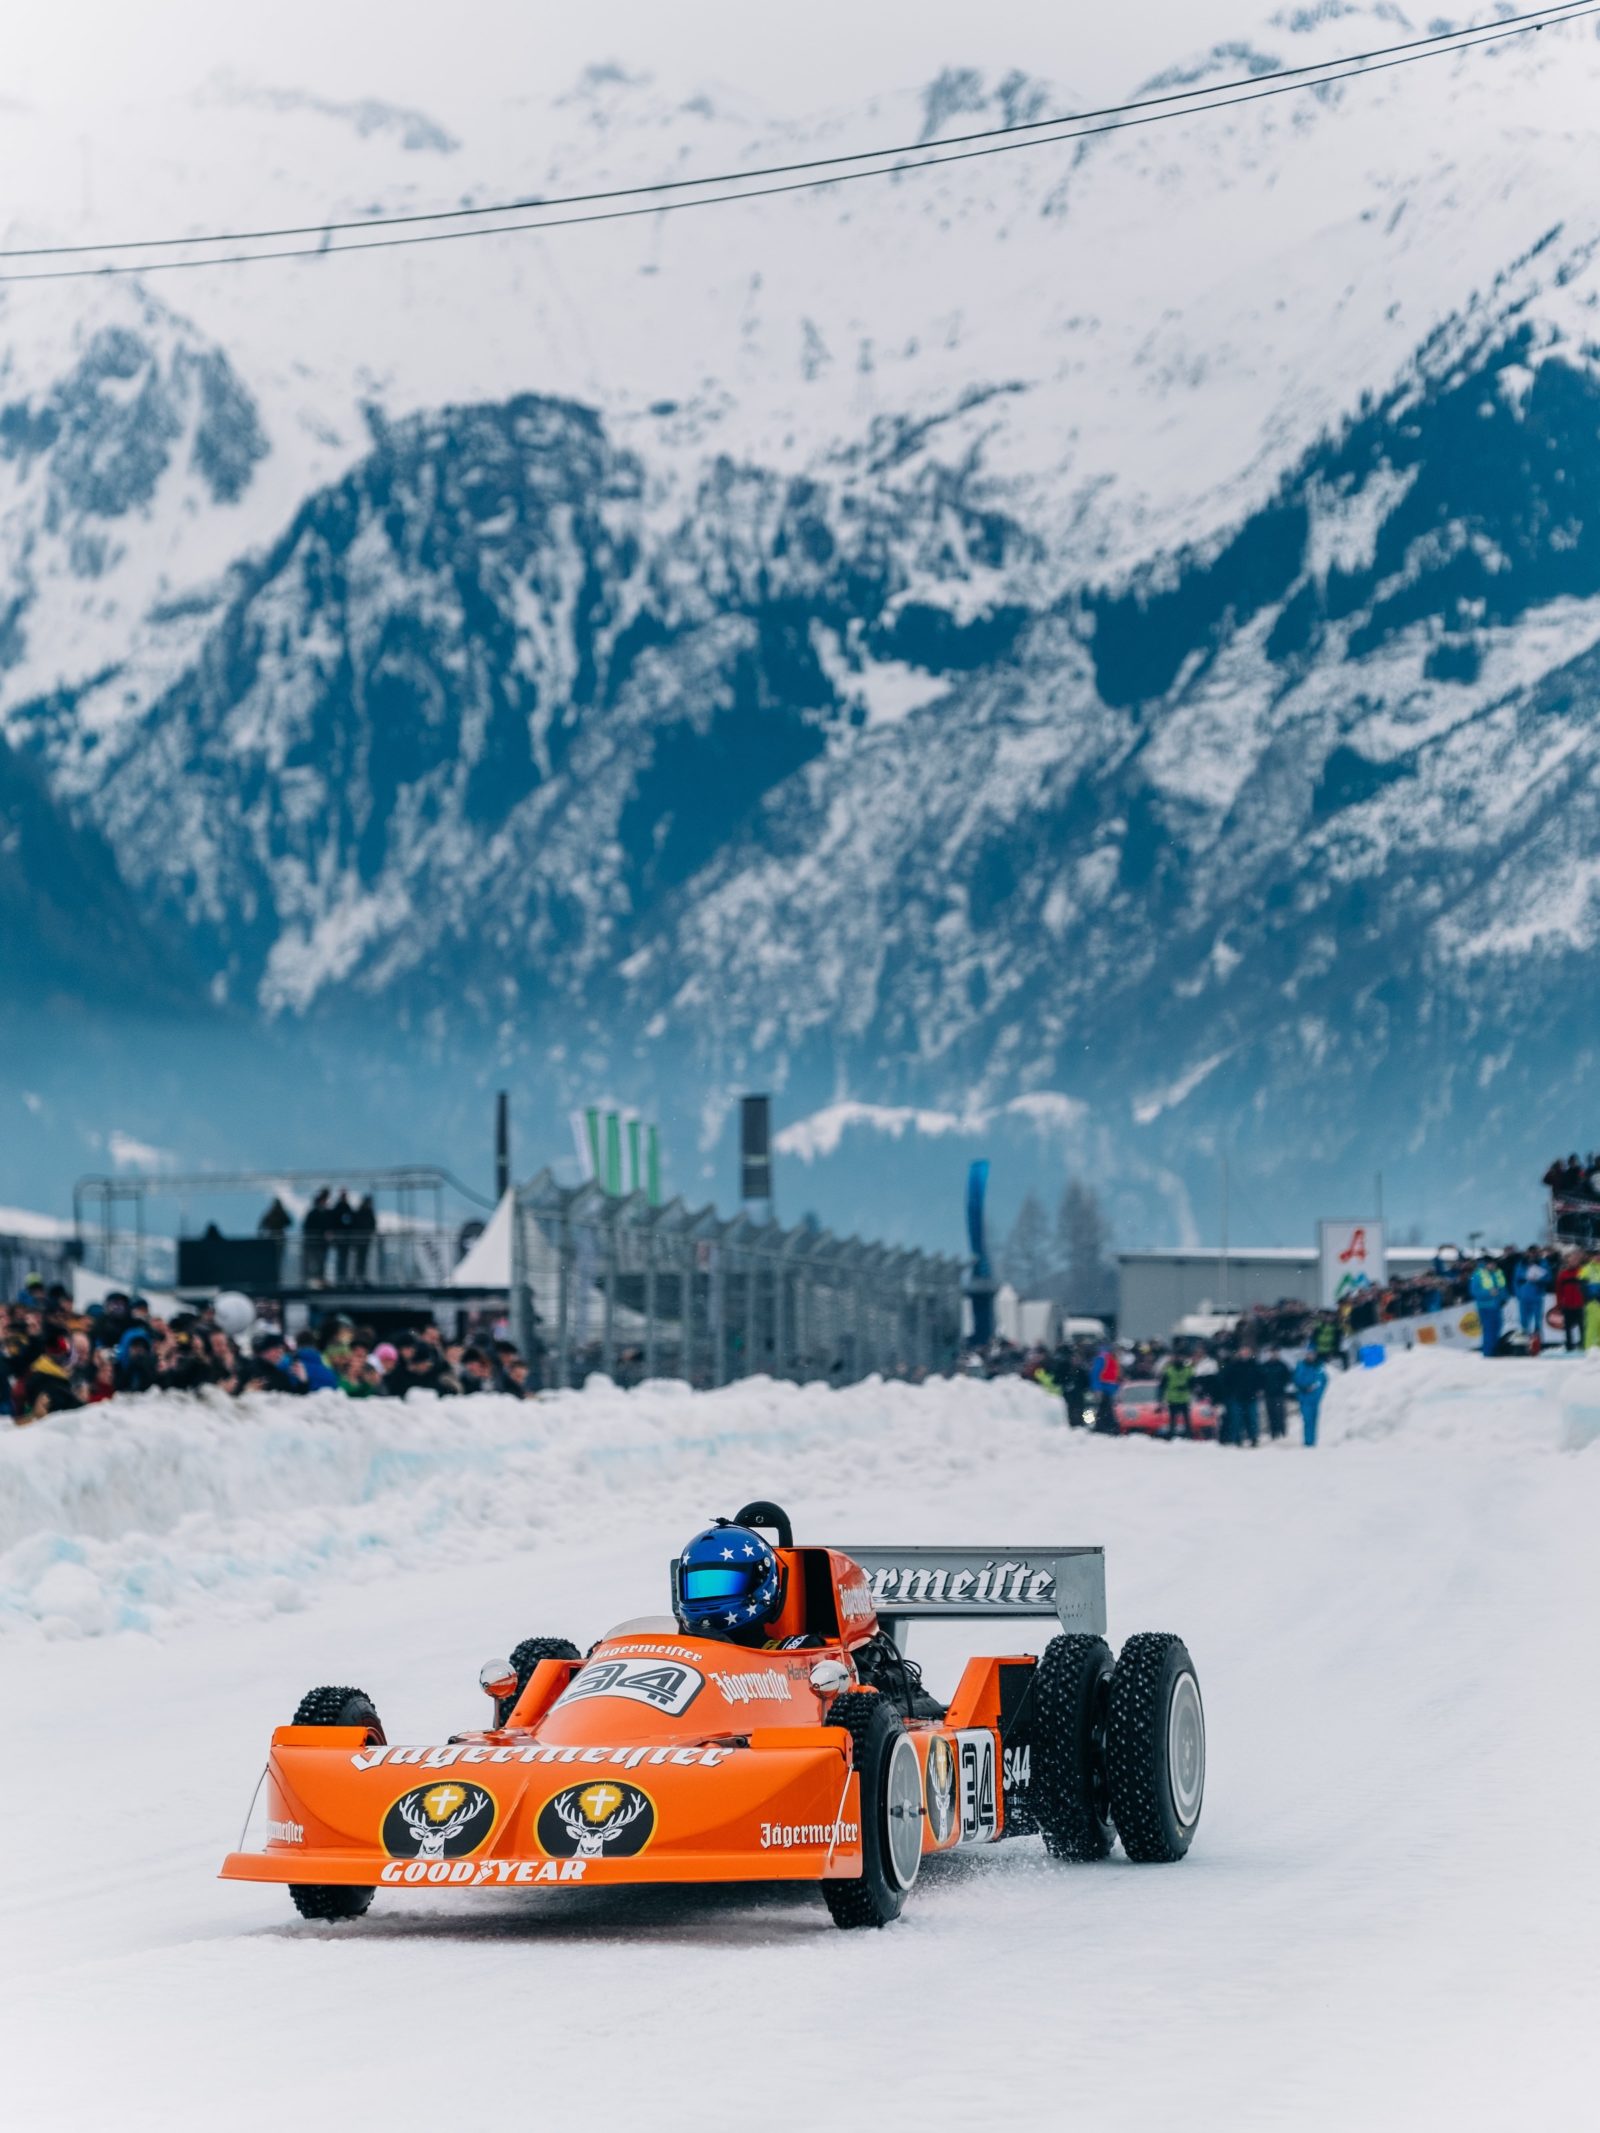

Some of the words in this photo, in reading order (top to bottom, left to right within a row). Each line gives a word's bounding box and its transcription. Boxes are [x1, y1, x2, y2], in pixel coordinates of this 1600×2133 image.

[862, 1560, 1056, 1599] rmeiste
[556, 1663, 678, 1705] 34
[1003, 1744, 1031, 1790] S44
[962, 1742, 994, 1840] 34
[760, 1822, 858, 1848] Jägermeister
[381, 1860, 587, 1885] GOODYEAR
